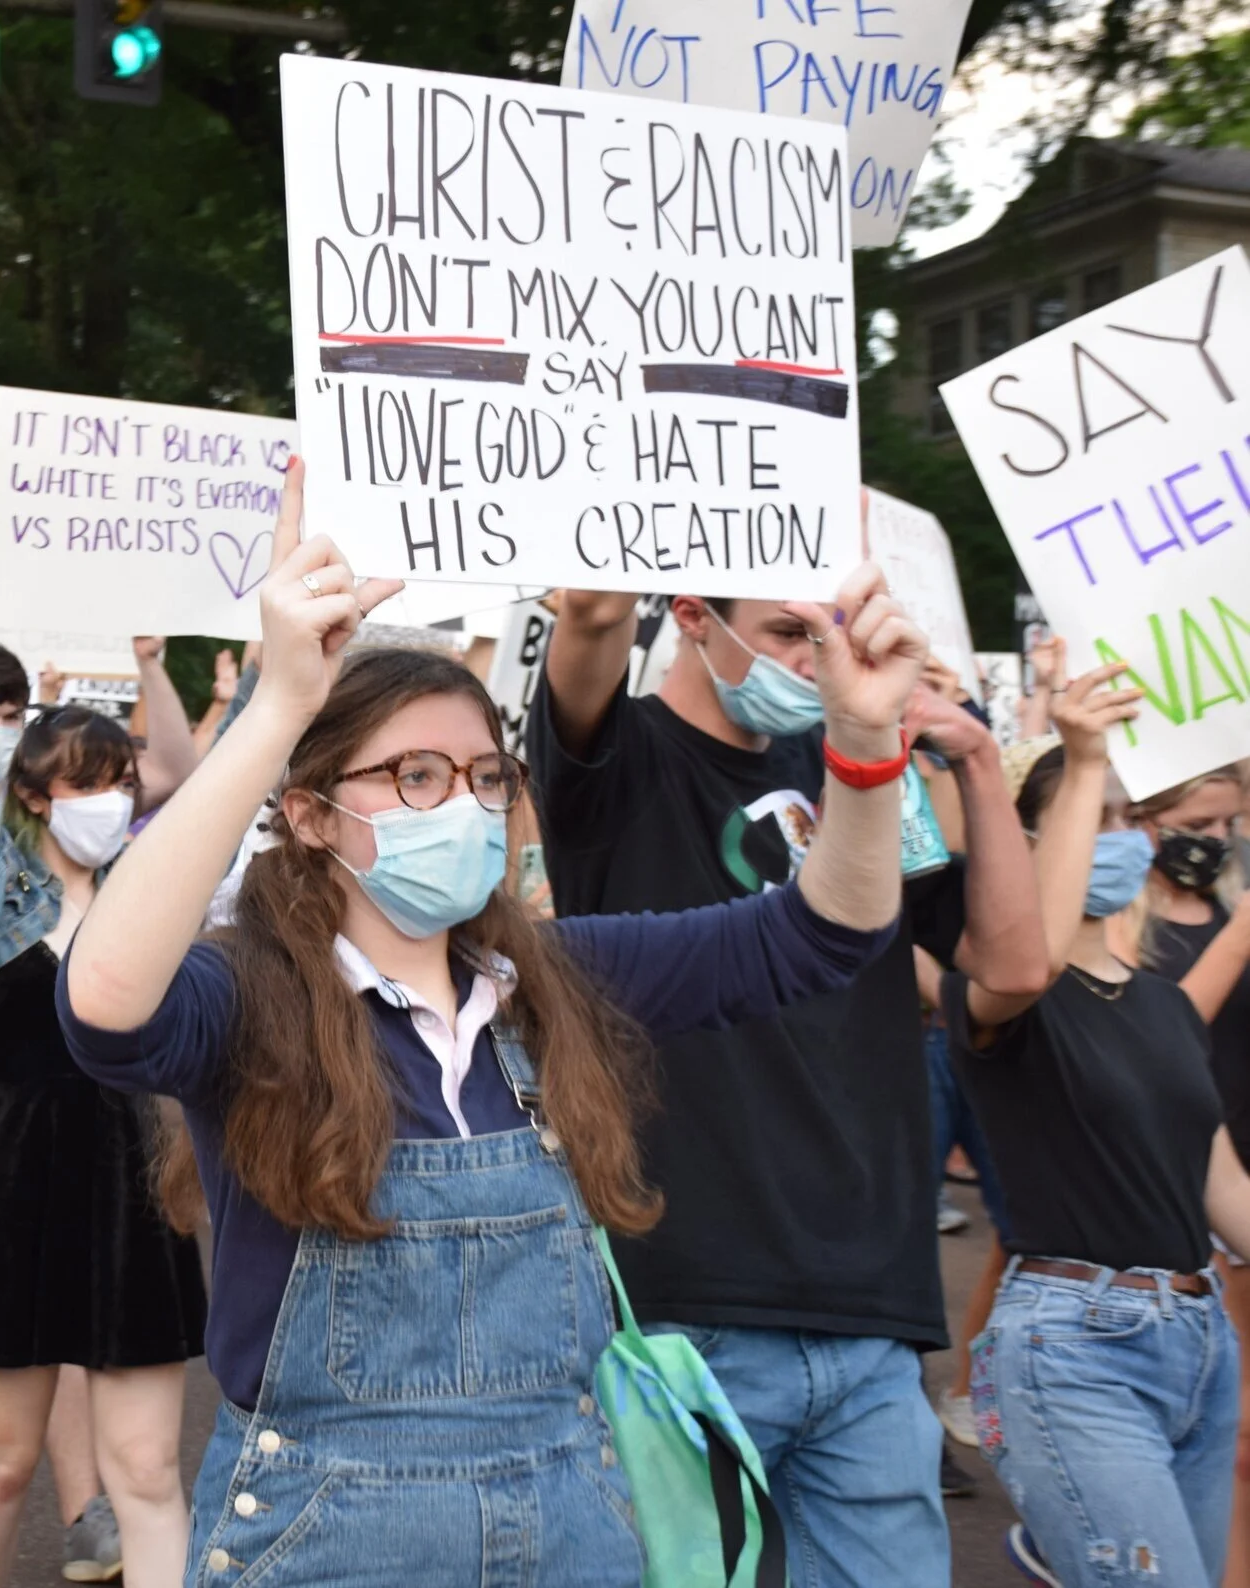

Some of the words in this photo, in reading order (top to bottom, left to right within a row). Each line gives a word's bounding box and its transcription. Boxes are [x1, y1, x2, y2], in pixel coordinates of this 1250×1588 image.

[577, 14, 701, 103] NOT
[754, 40, 943, 128] PAYING
[335, 80, 585, 246] CHRIST
[649, 121, 844, 263] RACISM
[316, 236, 491, 334] DON'T
[610, 270, 723, 357] YOU
[732, 285, 844, 370] CAN'T
[543, 351, 627, 401] SAY
[988, 264, 1236, 477] SAY
[11, 463, 118, 501] WHITE
[136, 476, 185, 508] IT'S
[197, 478, 283, 517] EVERYON
[12, 411, 48, 448] IT
[60, 413, 152, 459] ISN'T
[163, 424, 247, 466] BLACK
[260, 438, 291, 474] VS
[363, 385, 465, 492] LOVE
[631, 409, 780, 490] HATE
[12, 515, 50, 550] VS
[68, 517, 200, 556] RACISTS
[401, 497, 517, 572] HIS
[1034, 434, 1250, 586] THEI
